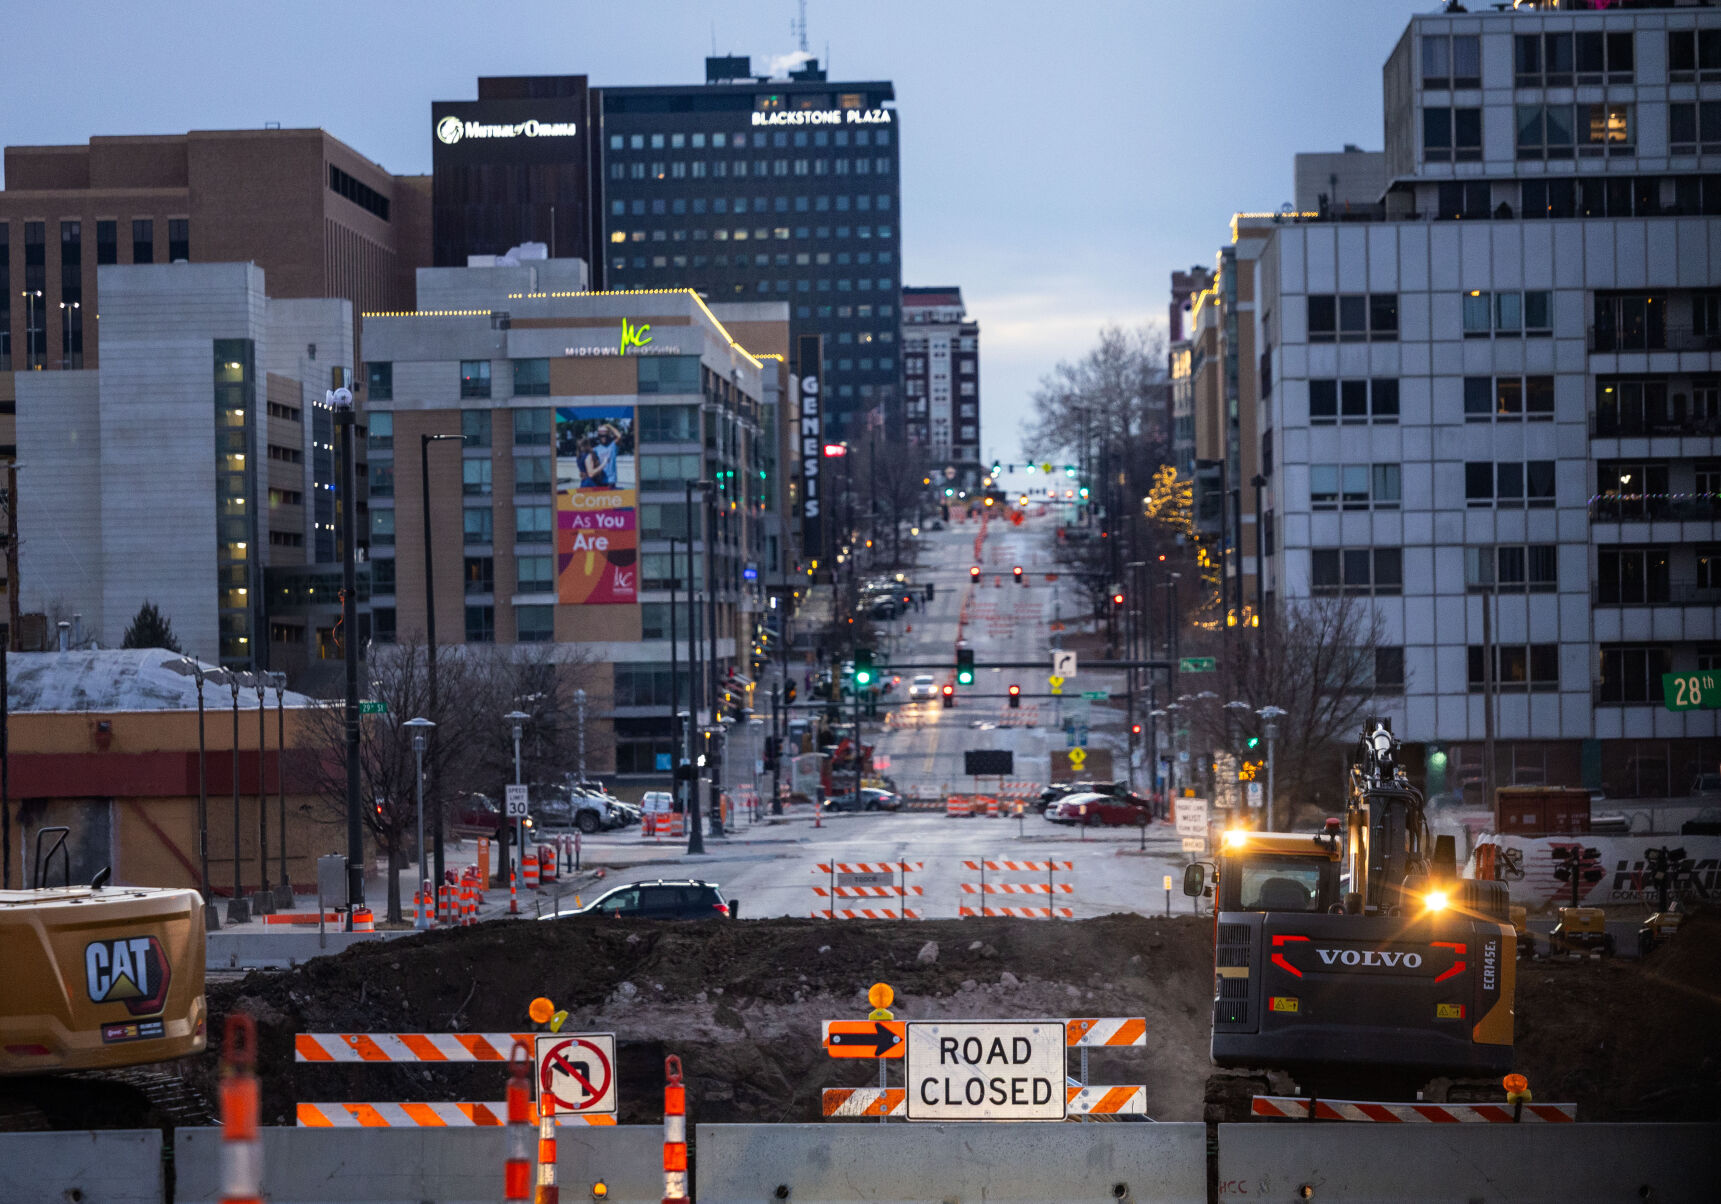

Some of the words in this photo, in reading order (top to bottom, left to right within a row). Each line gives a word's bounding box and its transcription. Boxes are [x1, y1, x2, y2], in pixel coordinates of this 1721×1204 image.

[752, 110, 841, 125] BLACKSTONE
[847, 109, 891, 124] PLAZA
[565, 346, 619, 355] MIDTOWN
[802, 376, 819, 518] GENESIS
[571, 493, 623, 508] Come
[572, 515, 592, 528] As
[595, 513, 625, 528] You
[573, 533, 609, 551] Are
[509, 802, 526, 814] 30
[1316, 949, 1422, 968] VOLVO
[86, 938, 150, 1001] CAT
[940, 1037, 1032, 1065] ROAD
[920, 1077, 1052, 1106] CLOSED
[1219, 1181, 1248, 1194] HCC
